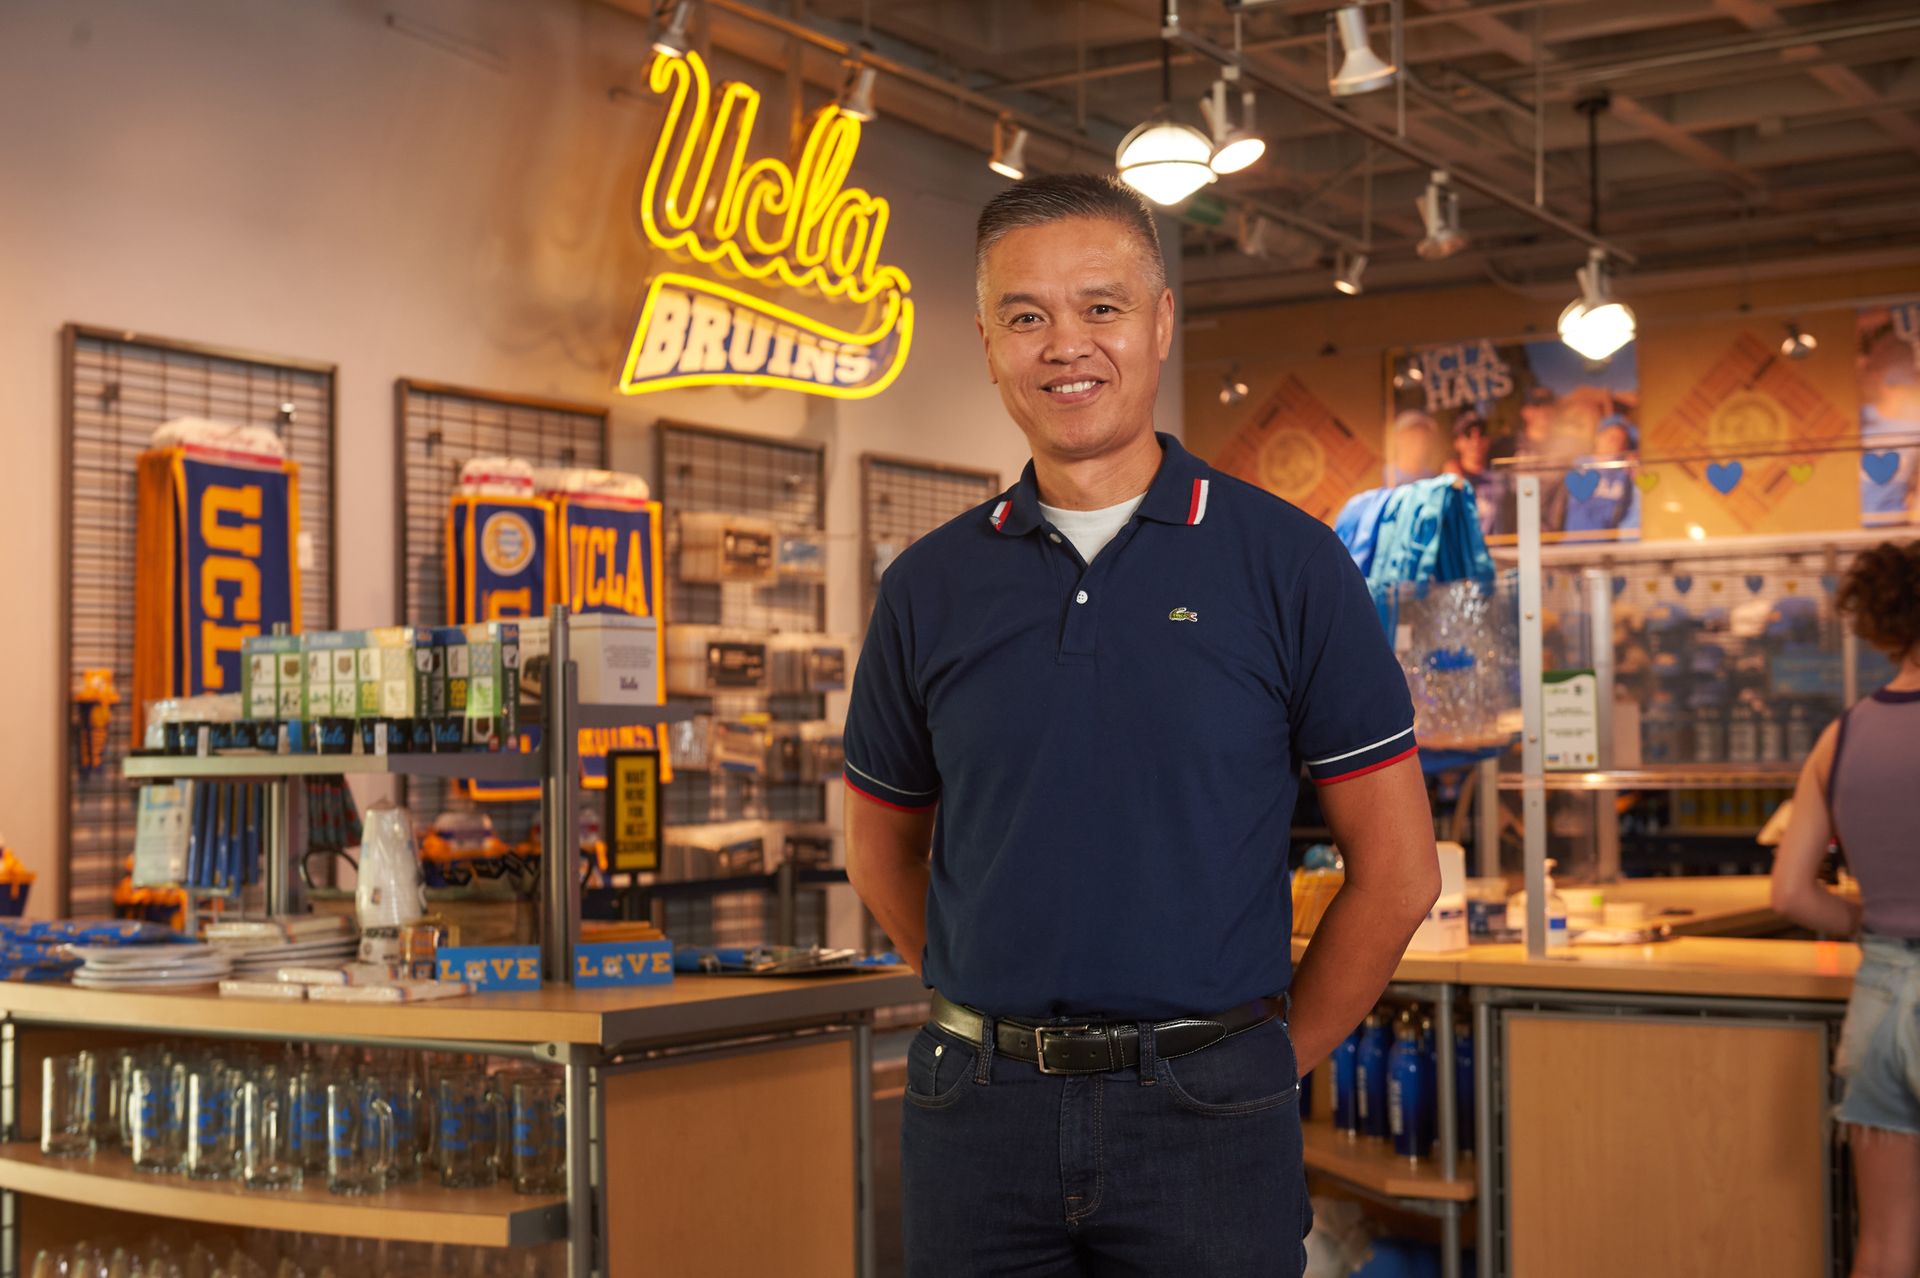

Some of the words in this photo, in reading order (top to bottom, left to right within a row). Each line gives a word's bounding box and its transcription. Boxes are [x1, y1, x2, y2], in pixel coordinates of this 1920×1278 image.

[634, 286, 877, 385] BRUINS
[1426, 361, 1514, 413] HATS
[200, 484, 263, 690] UCL
